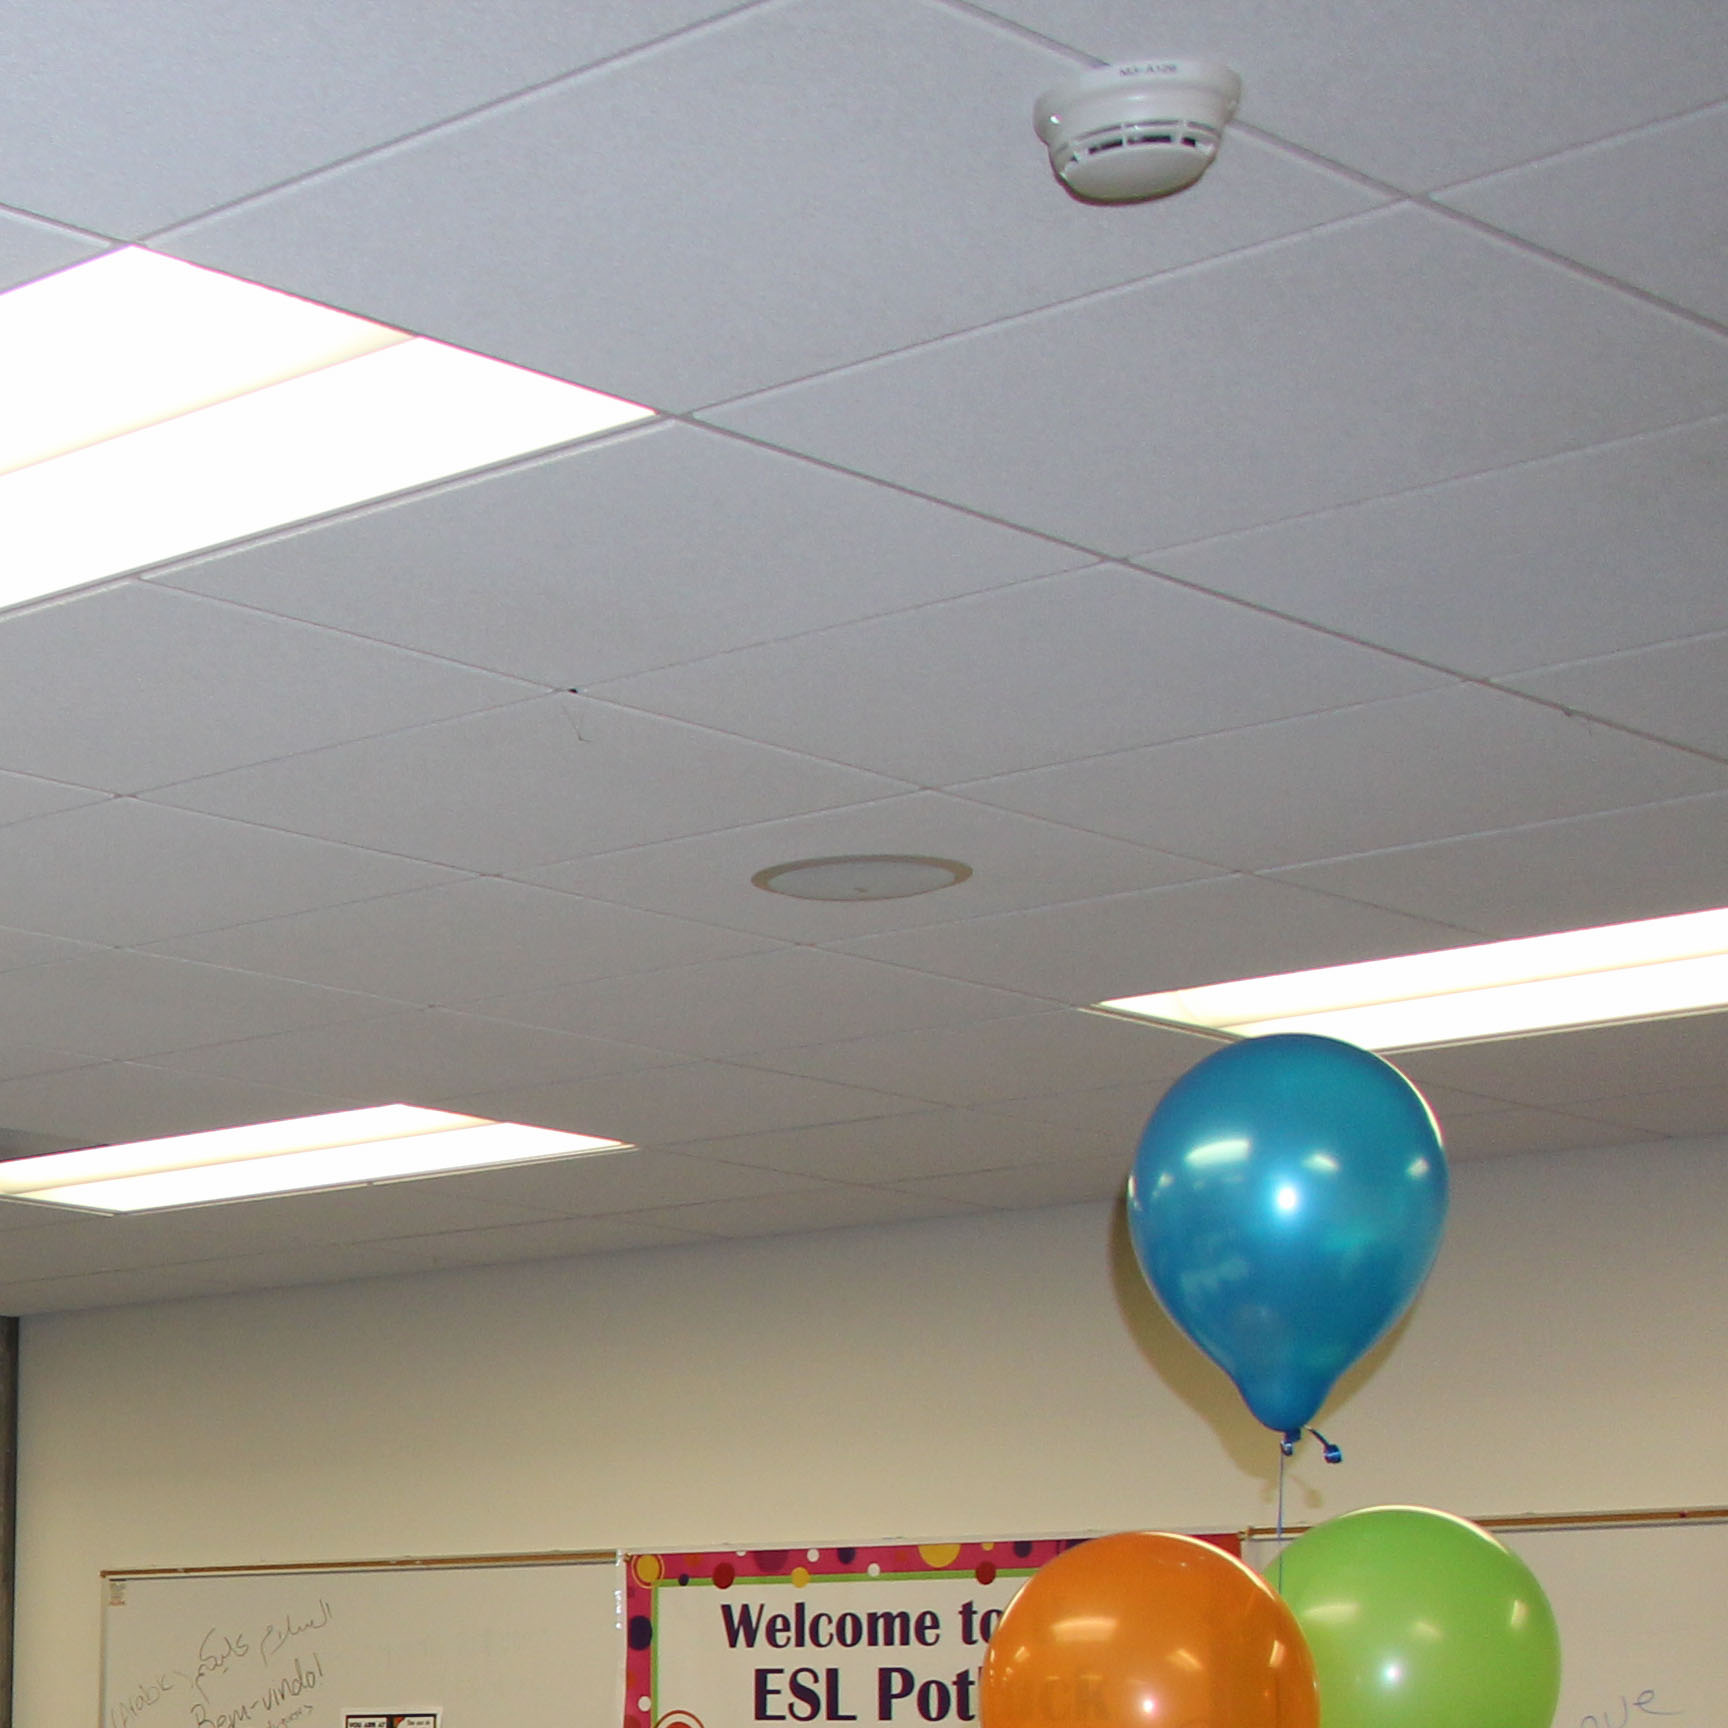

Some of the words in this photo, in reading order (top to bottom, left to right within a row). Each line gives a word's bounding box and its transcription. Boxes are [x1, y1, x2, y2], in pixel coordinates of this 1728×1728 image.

[720, 1601, 941, 1649] Welcome
[958, 1601, 1003, 1646] to
[754, 1667, 858, 1722] ESL
